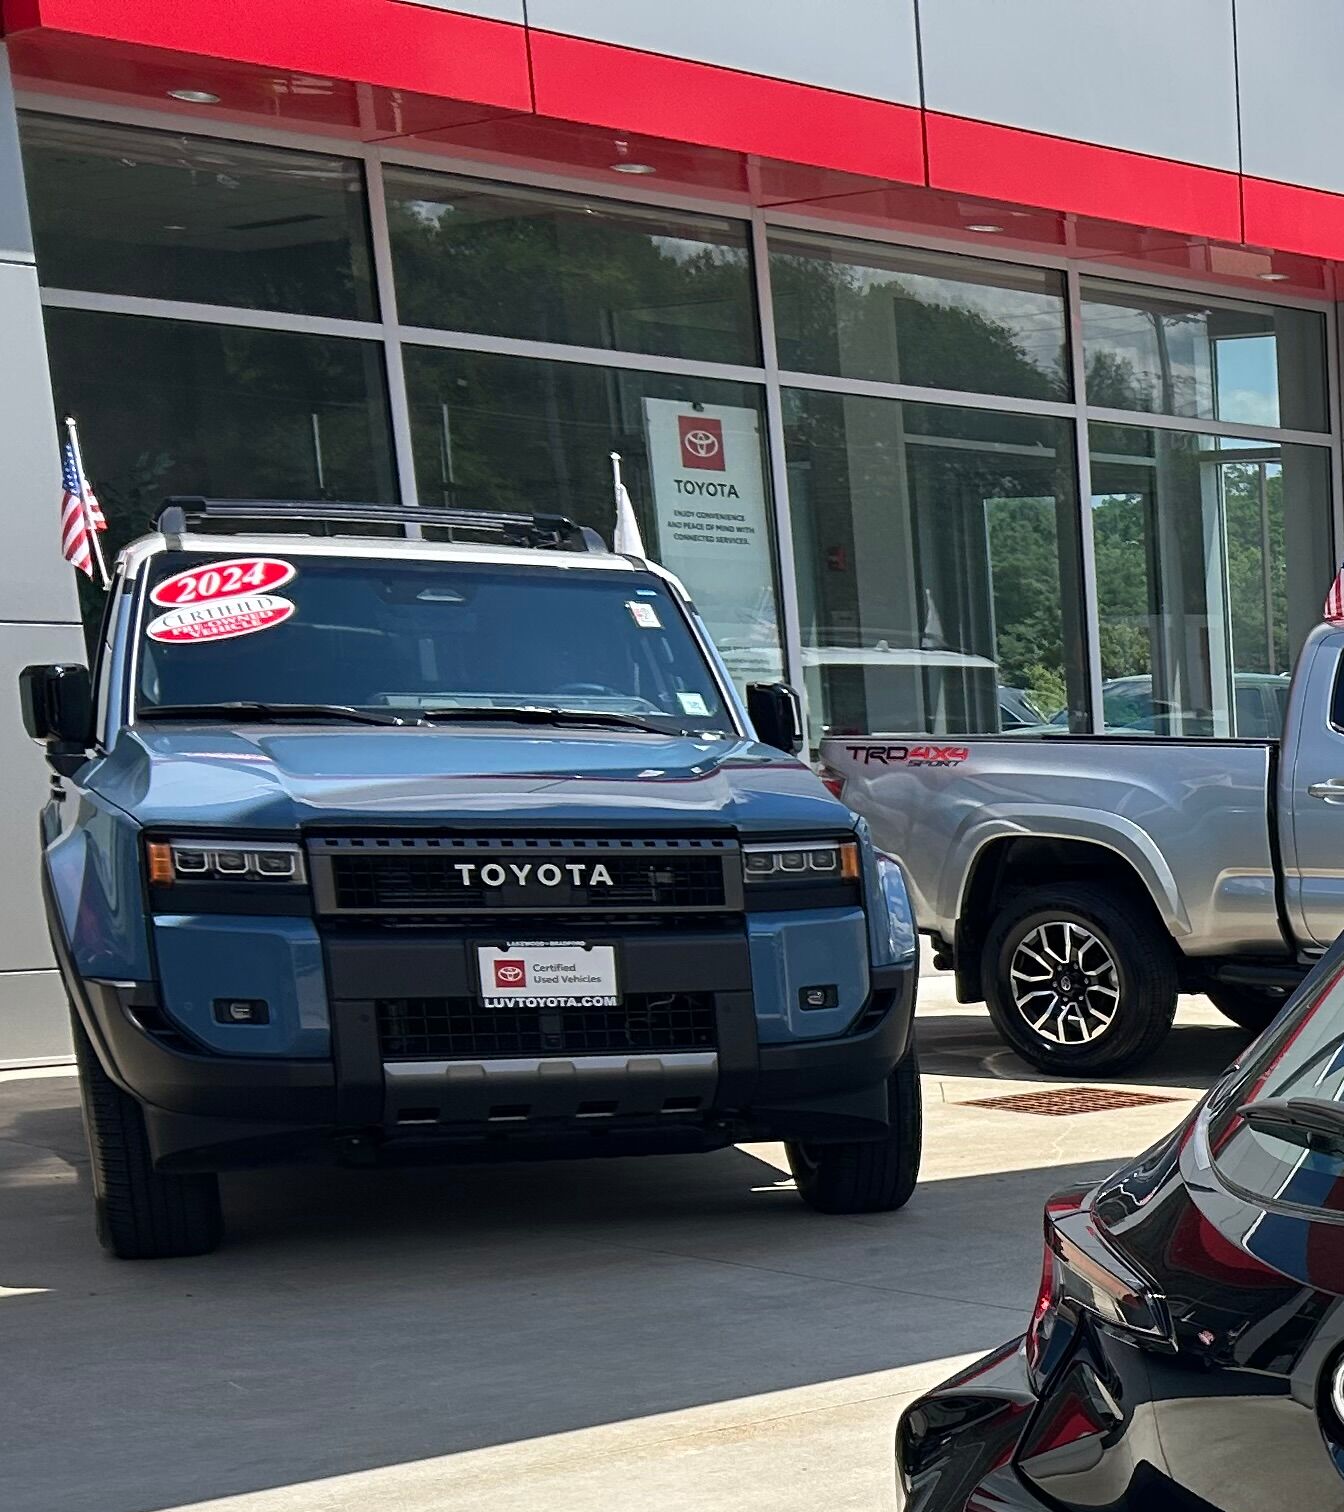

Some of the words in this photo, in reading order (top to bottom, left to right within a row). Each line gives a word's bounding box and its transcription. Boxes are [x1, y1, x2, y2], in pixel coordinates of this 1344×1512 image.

[674, 479, 740, 499] TOYOTA
[673, 509, 695, 518] ENJOY
[696, 511, 746, 522] CONVENIENCE
[667, 520, 682, 529] AND
[683, 522, 705, 531] PEACE
[716, 525, 735, 533] MIND
[736, 526, 755, 534] WITH
[673, 533, 715, 543] CONNECTED
[176, 562, 266, 602] 2024
[163, 597, 273, 627] CERTIFIED
[171, 609, 274, 636] PRE-OWNED
[190, 619, 263, 638] VEHICLE
[846, 746, 909, 765] TRD
[907, 759, 962, 768] SPORT
[454, 864, 614, 886] TOYOTA
[533, 964, 576, 972] Certified
[534, 975, 559, 983] Used
[561, 975, 601, 983] Vehicles
[484, 996, 617, 1008] LUVTOYOTA.COM
